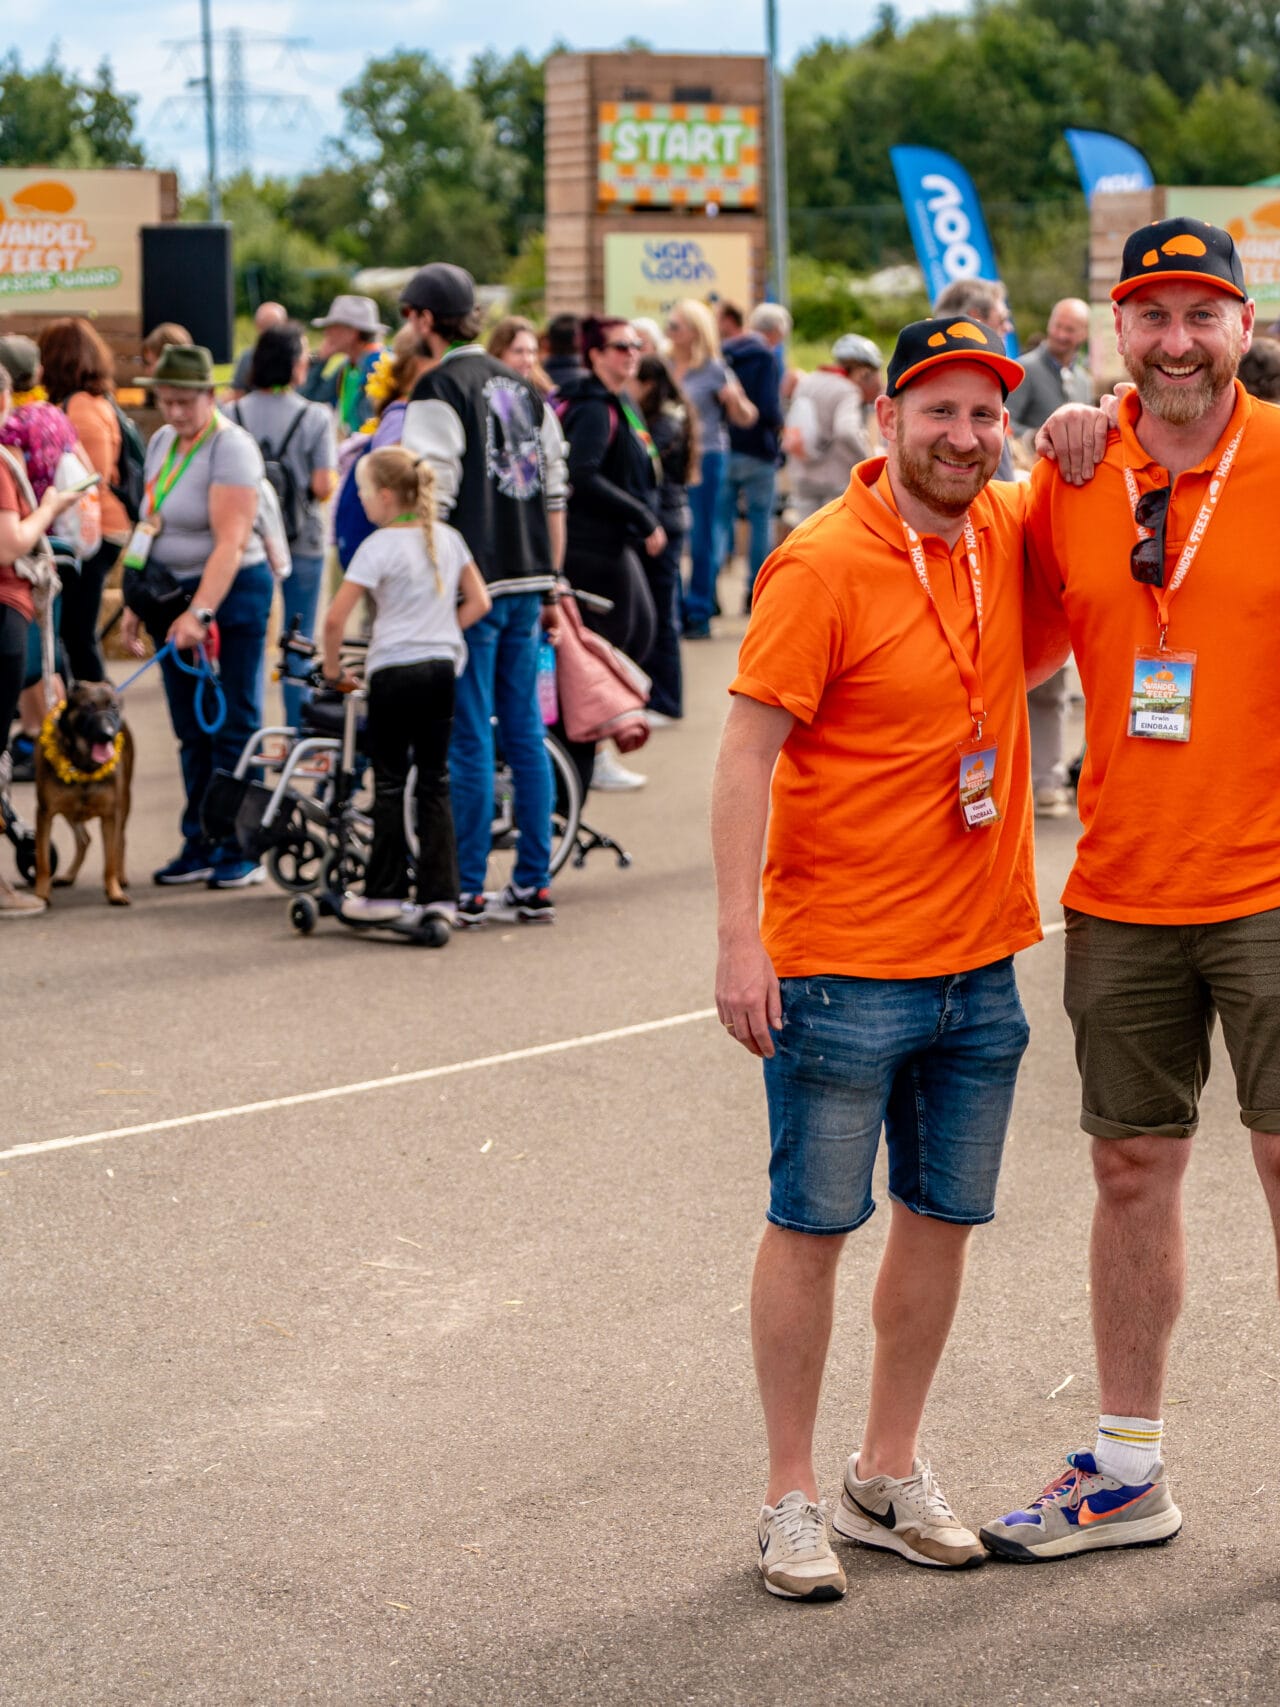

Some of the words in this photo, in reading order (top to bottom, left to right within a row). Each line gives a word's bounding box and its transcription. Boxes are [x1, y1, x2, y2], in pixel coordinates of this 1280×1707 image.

[613, 122, 742, 162] START
[1215, 424, 1246, 479] HOEKS
[1124, 465, 1142, 514] HOEKS
[1169, 545, 1198, 591] WANDEL
[1189, 504, 1213, 545] FEEST
[910, 545, 935, 601] HOEKS
[1142, 682, 1178, 692] WANDEL
[1145, 690, 1174, 699] FEEST
[1140, 723, 1179, 731] EINDBAAS
[1151, 714, 1170, 722] Erwin
[969, 808, 994, 822] EINDBAAS
